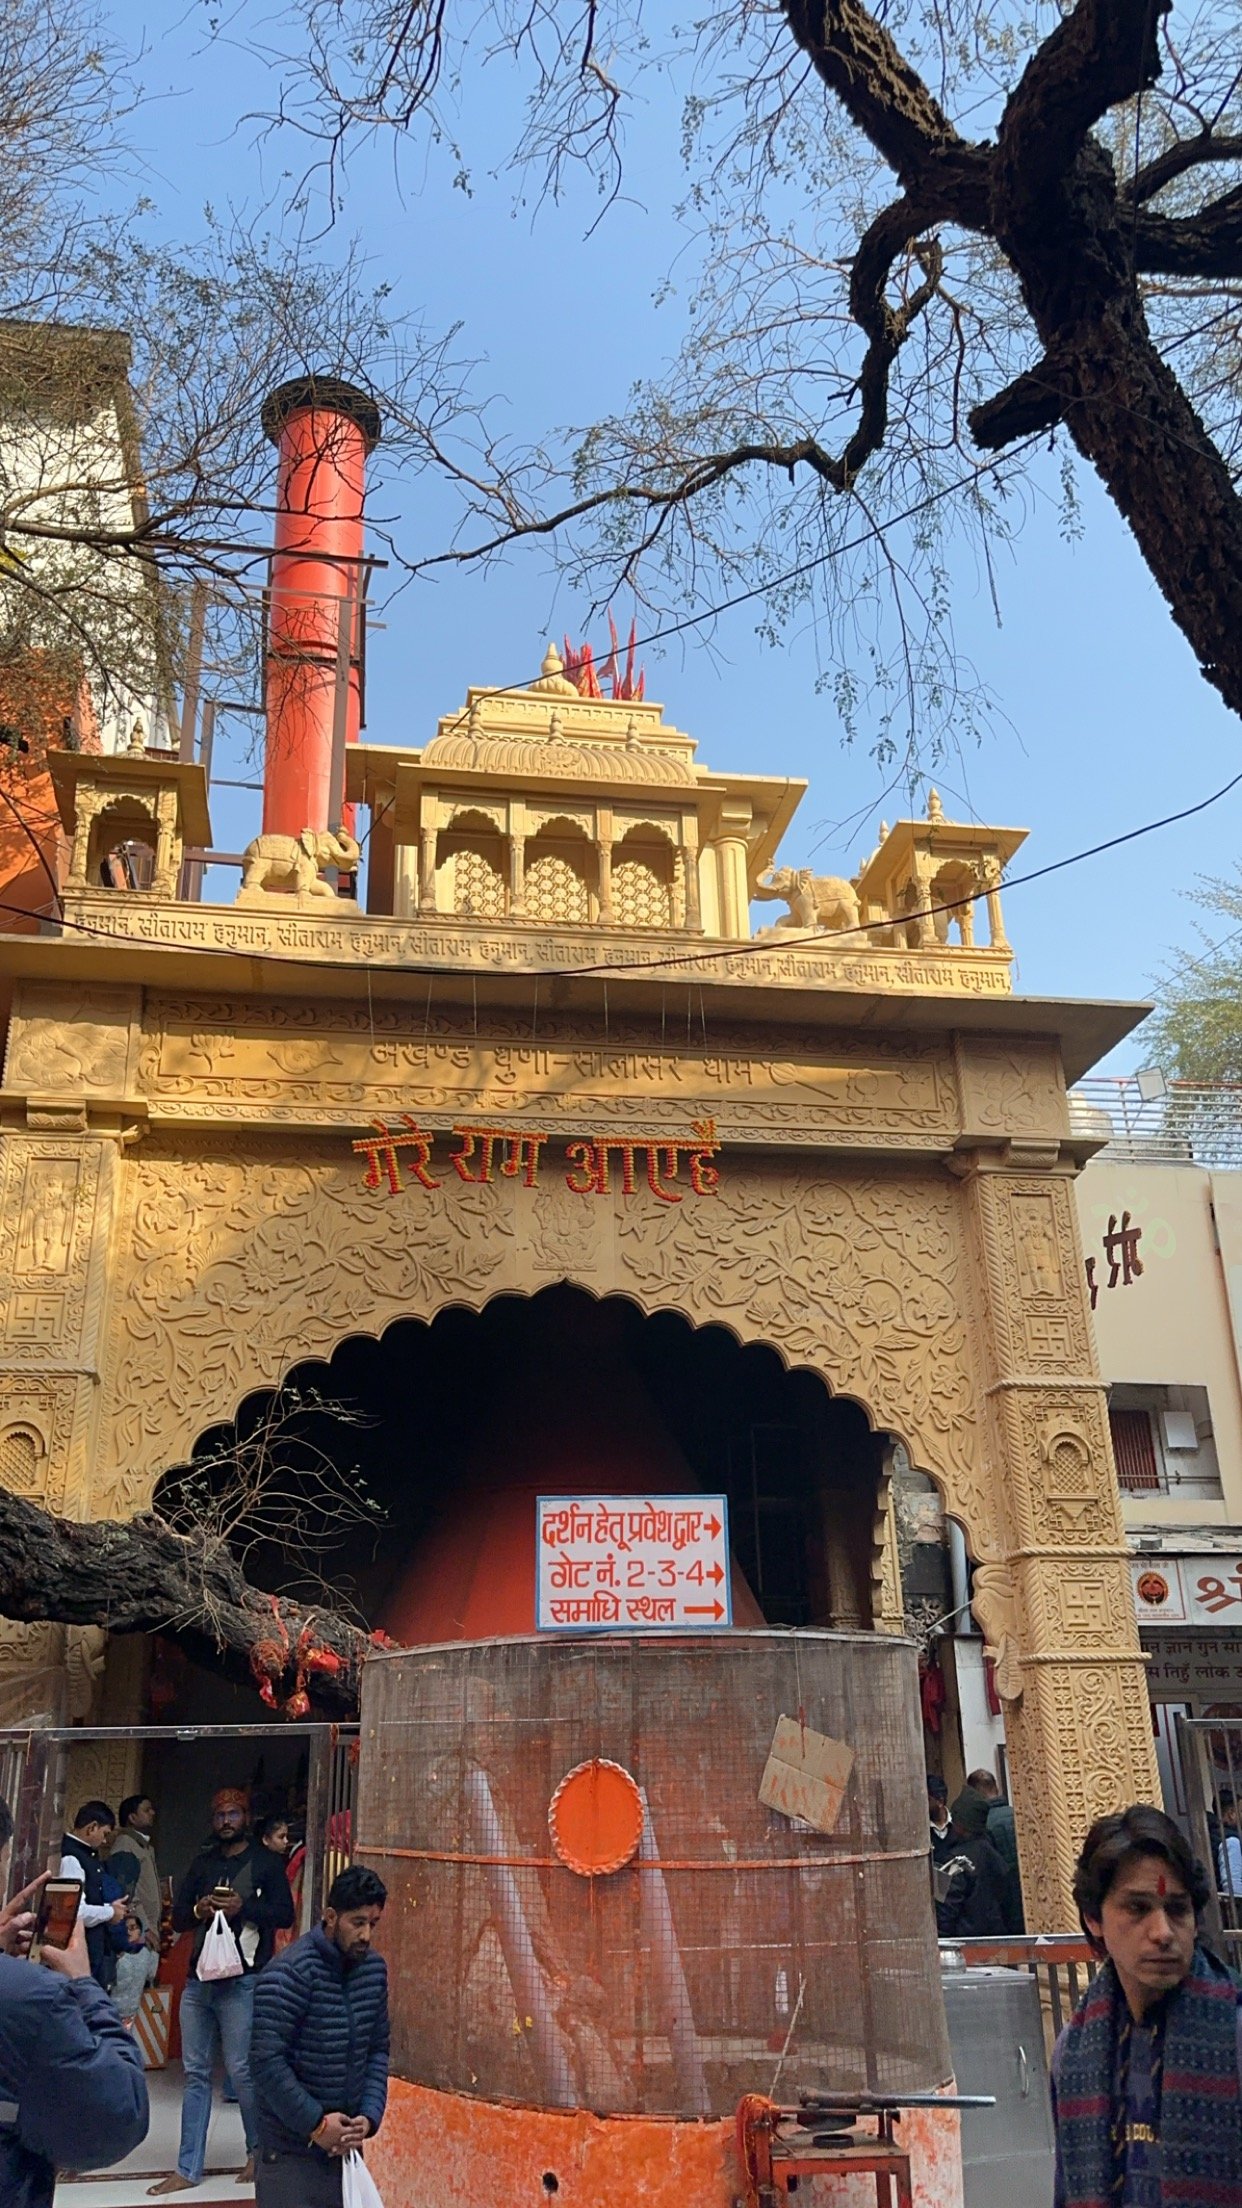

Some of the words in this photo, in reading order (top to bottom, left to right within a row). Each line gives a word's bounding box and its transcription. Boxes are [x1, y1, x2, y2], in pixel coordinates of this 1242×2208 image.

[138, 912, 207, 941] सीताराम
[277, 922, 344, 950] सीताराम
[409, 930, 473, 958] सीताराम
[535, 938, 598, 965] सीताराम
[777, 954, 838, 980] सीताराम
[895, 961, 954, 986] सीताराम
[370, 1041, 475, 1069] अखण्ड
[702, 1057, 753, 1085] धाम
[352, 1113, 441, 1195] मेरे
[448, 1124, 549, 1188] राम
[542, 1503, 594, 1548] दर्शन
[627, 1502, 673, 1543] प्रवेश
[672, 1511, 703, 1551] द्वार
[548, 1551, 593, 1588] गेट
[596, 1553, 621, 1588] नं.
[550, 1590, 622, 1623] समाधि
[626, 1596, 676, 1622] स्थल
[1195, 1661, 1230, 1679] लोक
